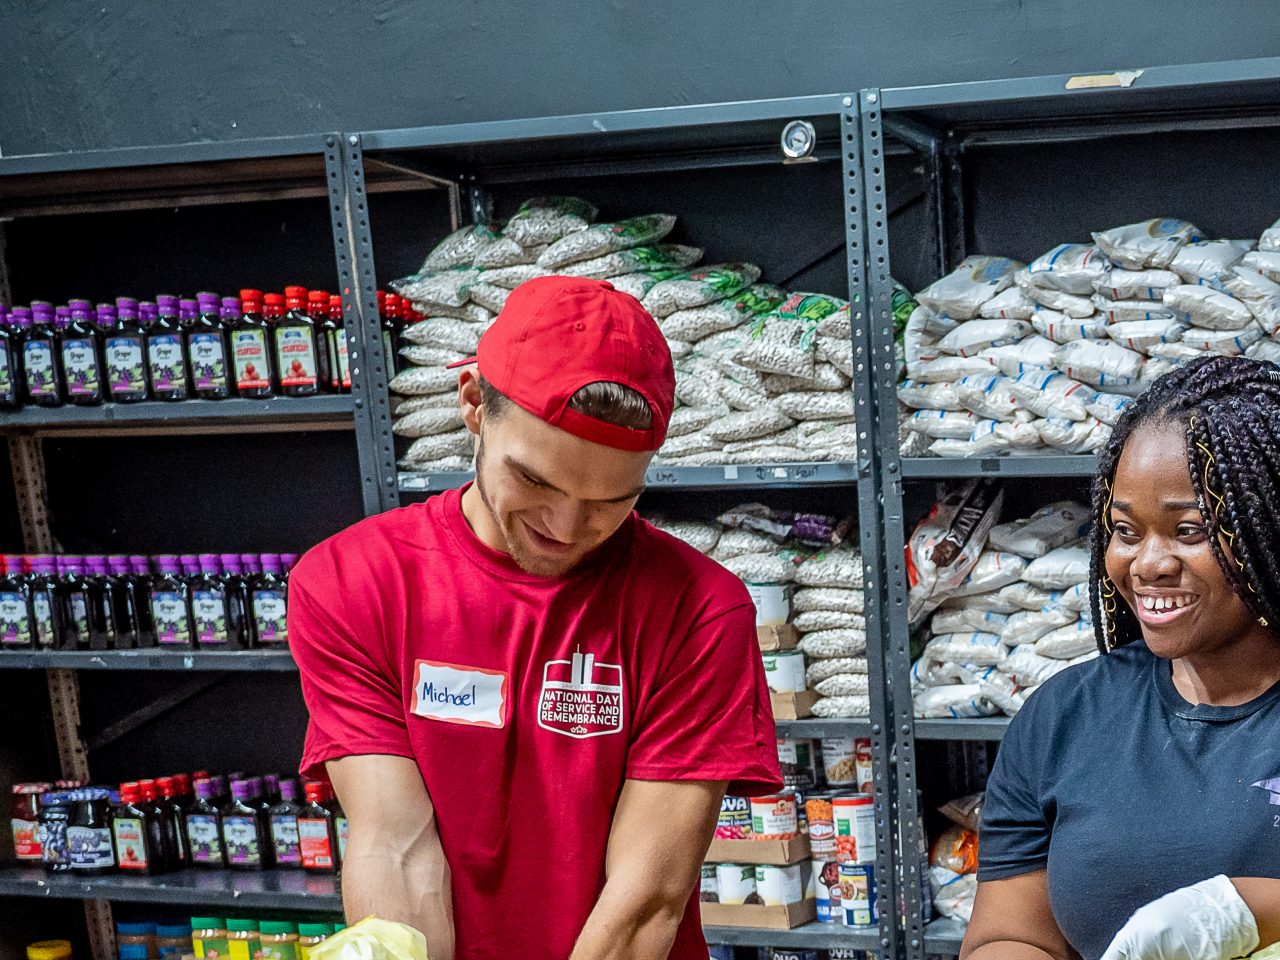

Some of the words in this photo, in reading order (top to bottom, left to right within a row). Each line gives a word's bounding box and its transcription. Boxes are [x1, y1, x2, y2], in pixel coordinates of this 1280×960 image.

[422, 682, 476, 707] Michael
[544, 691, 593, 703] NATIONAL
[596, 694, 619, 705] DAY
[542, 701, 553, 710] OF
[556, 702, 596, 714] SERVICE
[599, 706, 619, 715] AND
[541, 711, 618, 726] REMEMBRANCE
[723, 798, 747, 811] OYA
[829, 948, 853, 959] OYA
